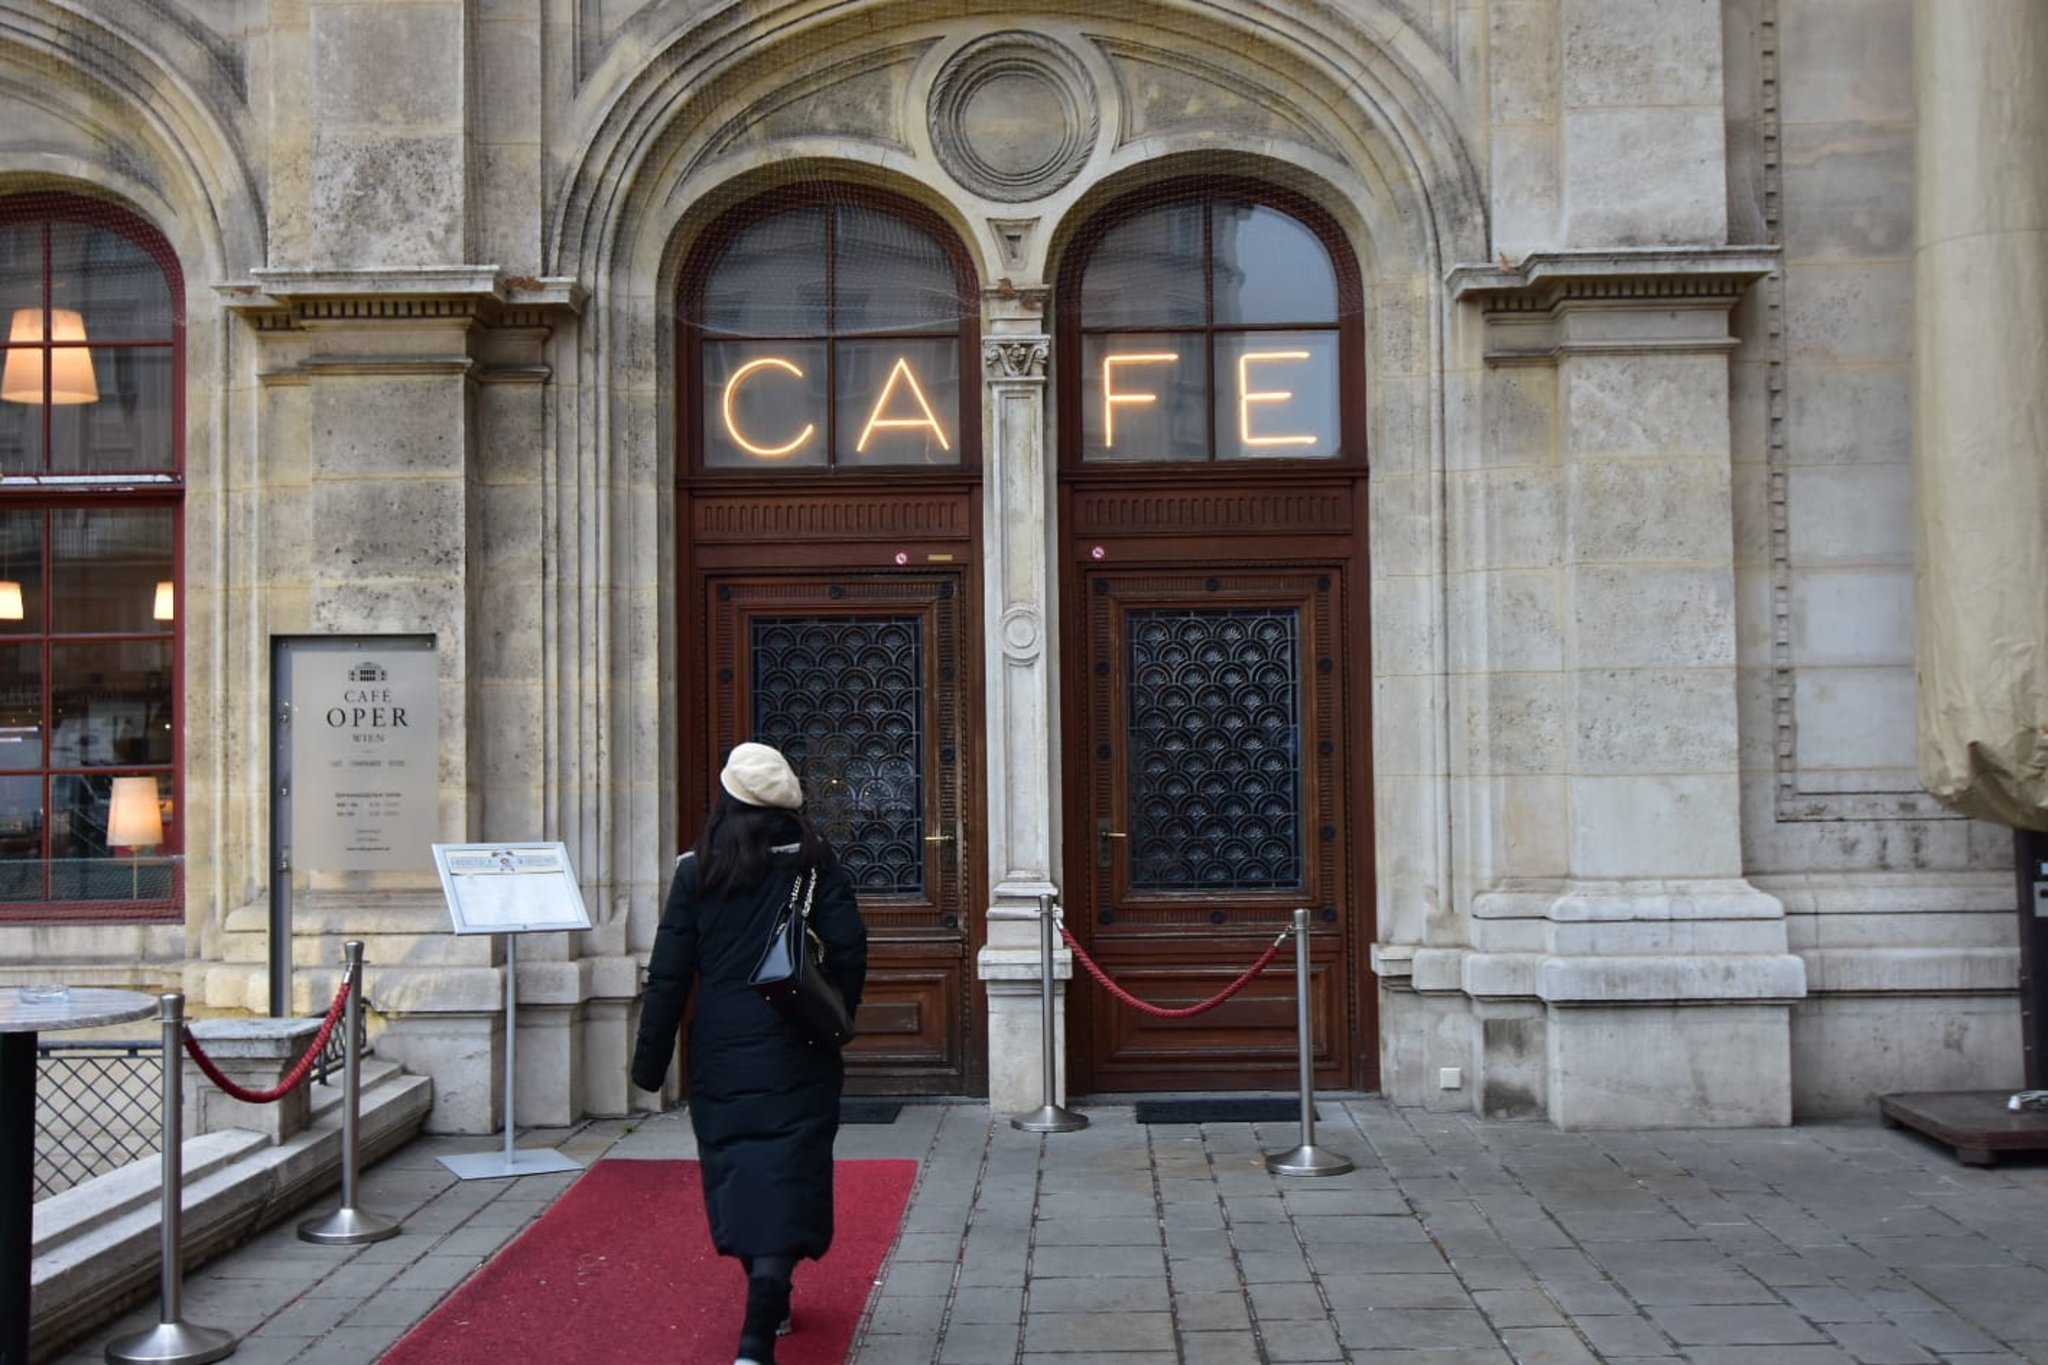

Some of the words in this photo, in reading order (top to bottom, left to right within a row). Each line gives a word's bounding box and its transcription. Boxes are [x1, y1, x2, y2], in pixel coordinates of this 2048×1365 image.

[722, 350, 1318, 458] CAFE
[344, 686, 392, 703] CAFÉ
[326, 707, 409, 728] OPER
[352, 733, 385, 743] WIEN
